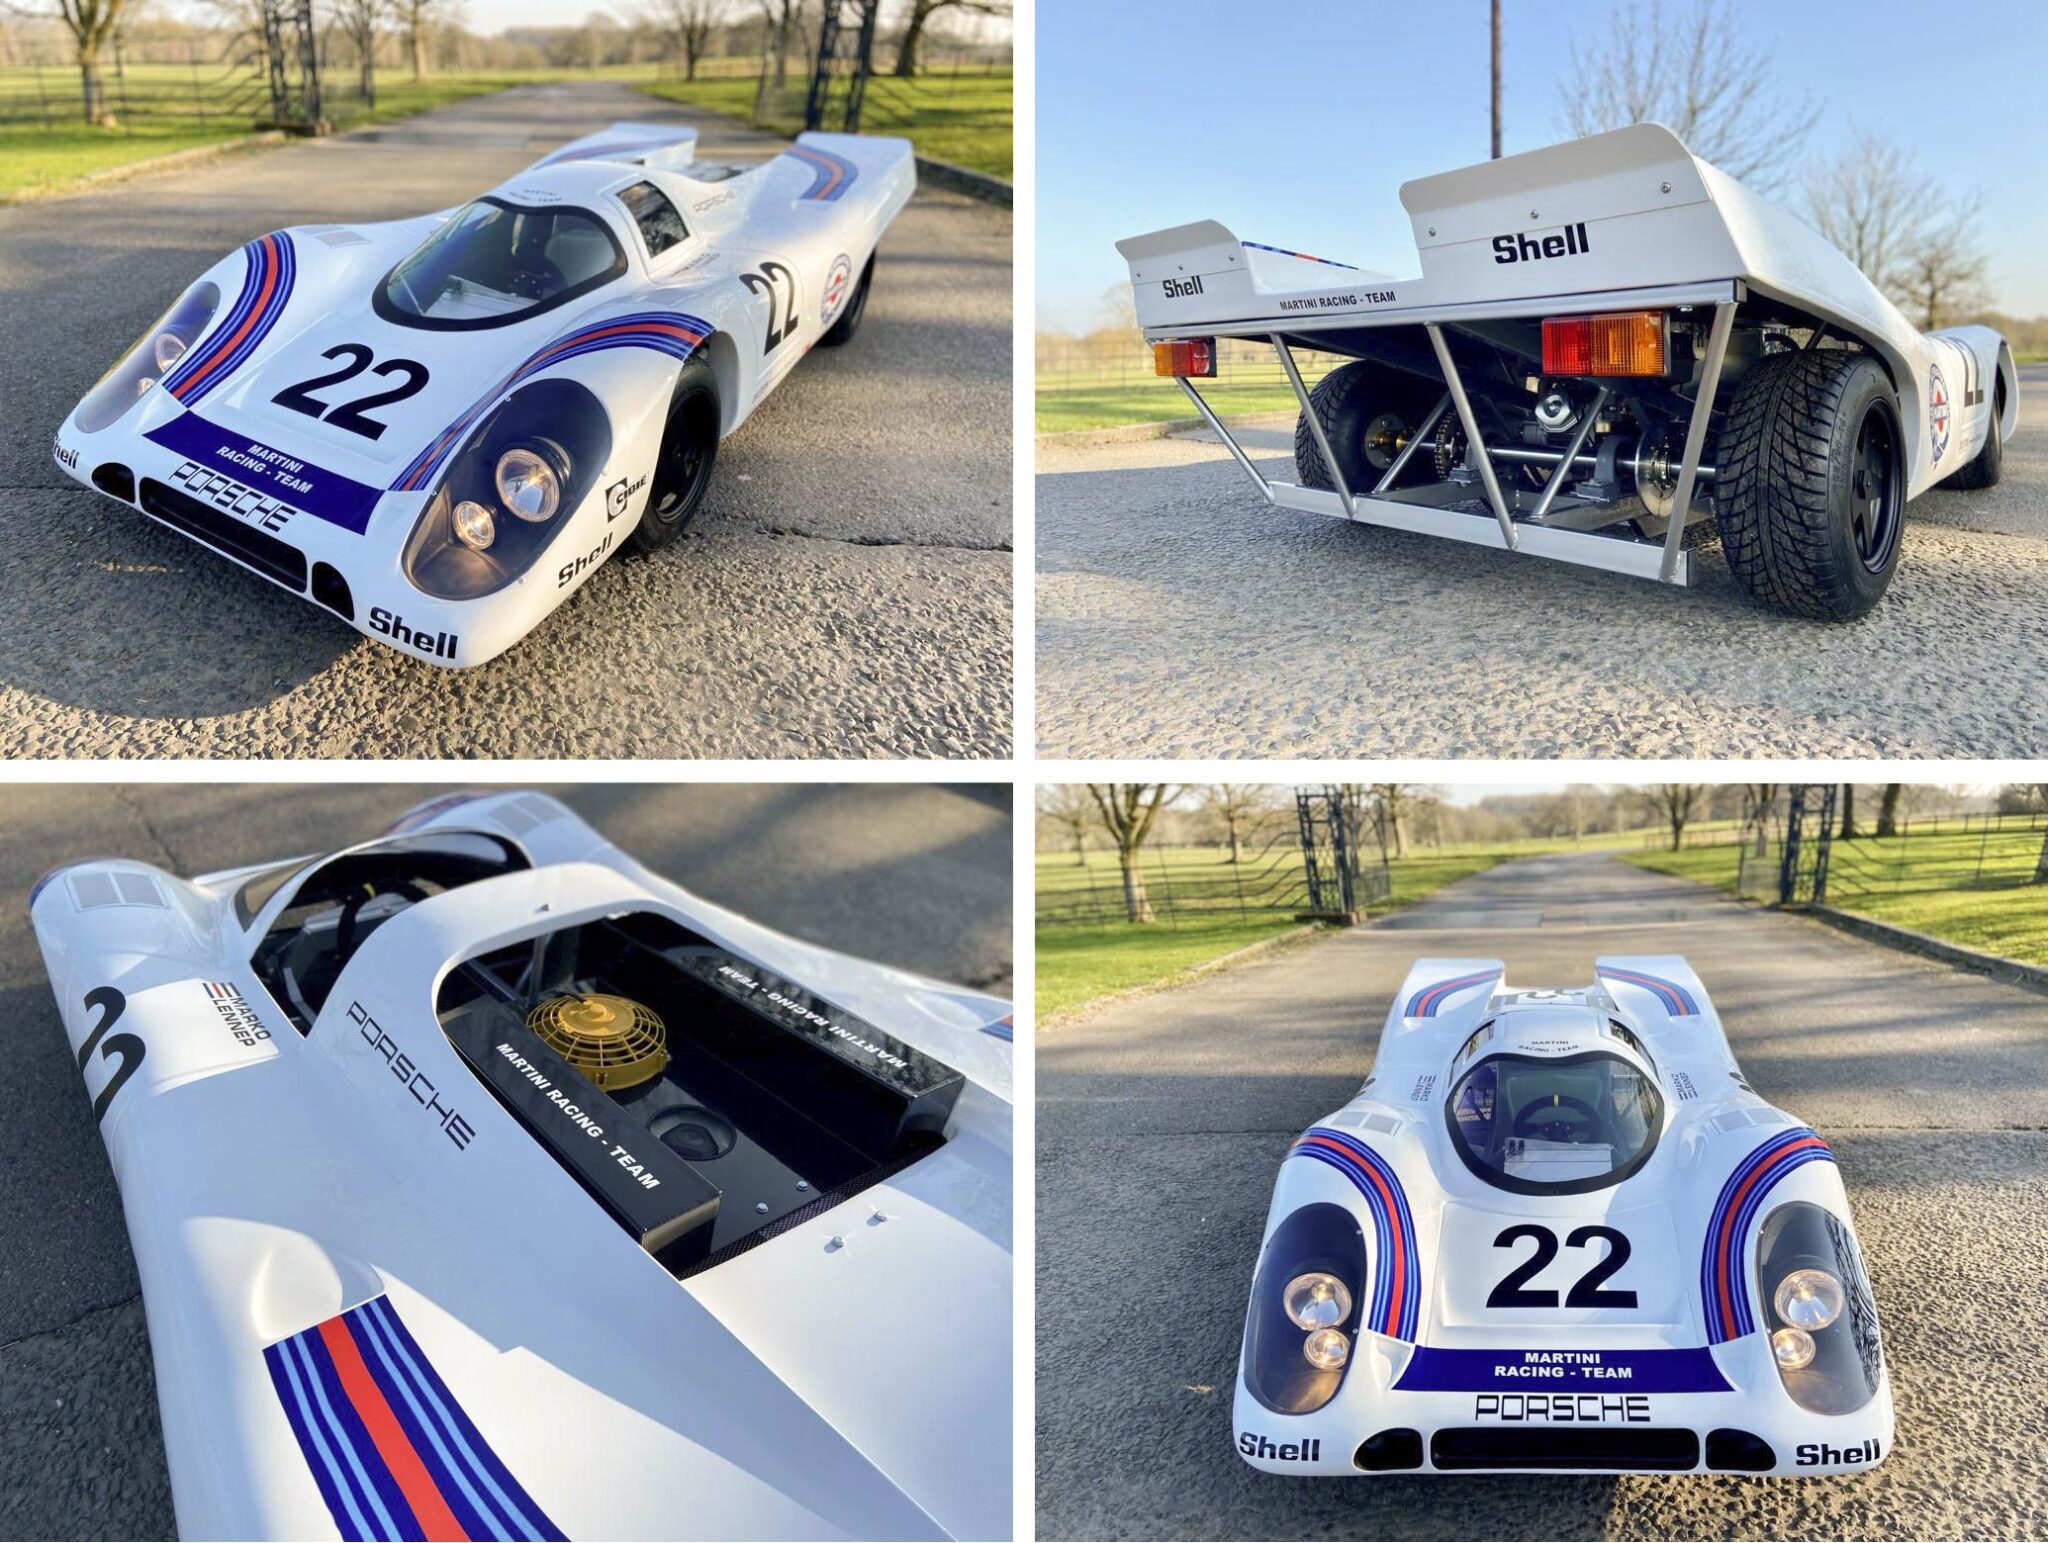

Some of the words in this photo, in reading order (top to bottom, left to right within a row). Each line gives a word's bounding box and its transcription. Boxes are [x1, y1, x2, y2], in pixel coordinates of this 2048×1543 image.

[1492, 222, 1590, 264] Shell
[1162, 275, 1204, 298] Shell
[1279, 298, 1318, 311] MARTINI
[1320, 295, 1357, 308] RACING
[1365, 291, 1397, 304] TEAM
[739, 262, 799, 357] 22
[270, 343, 430, 442] 22
[53, 437, 80, 469] hell
[216, 446, 267, 473] RACING
[273, 471, 314, 494] TEAM
[247, 444, 305, 473] MARTINI
[169, 461, 297, 533] PORSCHE
[558, 532, 613, 589] Shell
[369, 606, 459, 659] Shell
[718, 965, 761, 989] TEAM
[211, 999, 257, 1047] LENNEP
[230, 997, 272, 1040] MARKO
[767, 992, 830, 1027] RACING
[828, 1026, 909, 1068] MARTINI
[346, 1000, 477, 1151] PORSCHE
[496, 1043, 552, 1090] MARTINI
[546, 1089, 604, 1138] RACING
[609, 1145, 661, 1190] TEAM
[1486, 1224, 1638, 1308] 22
[1494, 1366, 1564, 1378] RACING
[1581, 1367, 1633, 1378] TEAM
[1525, 1352, 1601, 1364] MARTINI
[1475, 1394, 1651, 1422] PORSCHE
[1239, 1431, 1320, 1461] Shell
[1796, 1438, 1880, 1466] Shell
